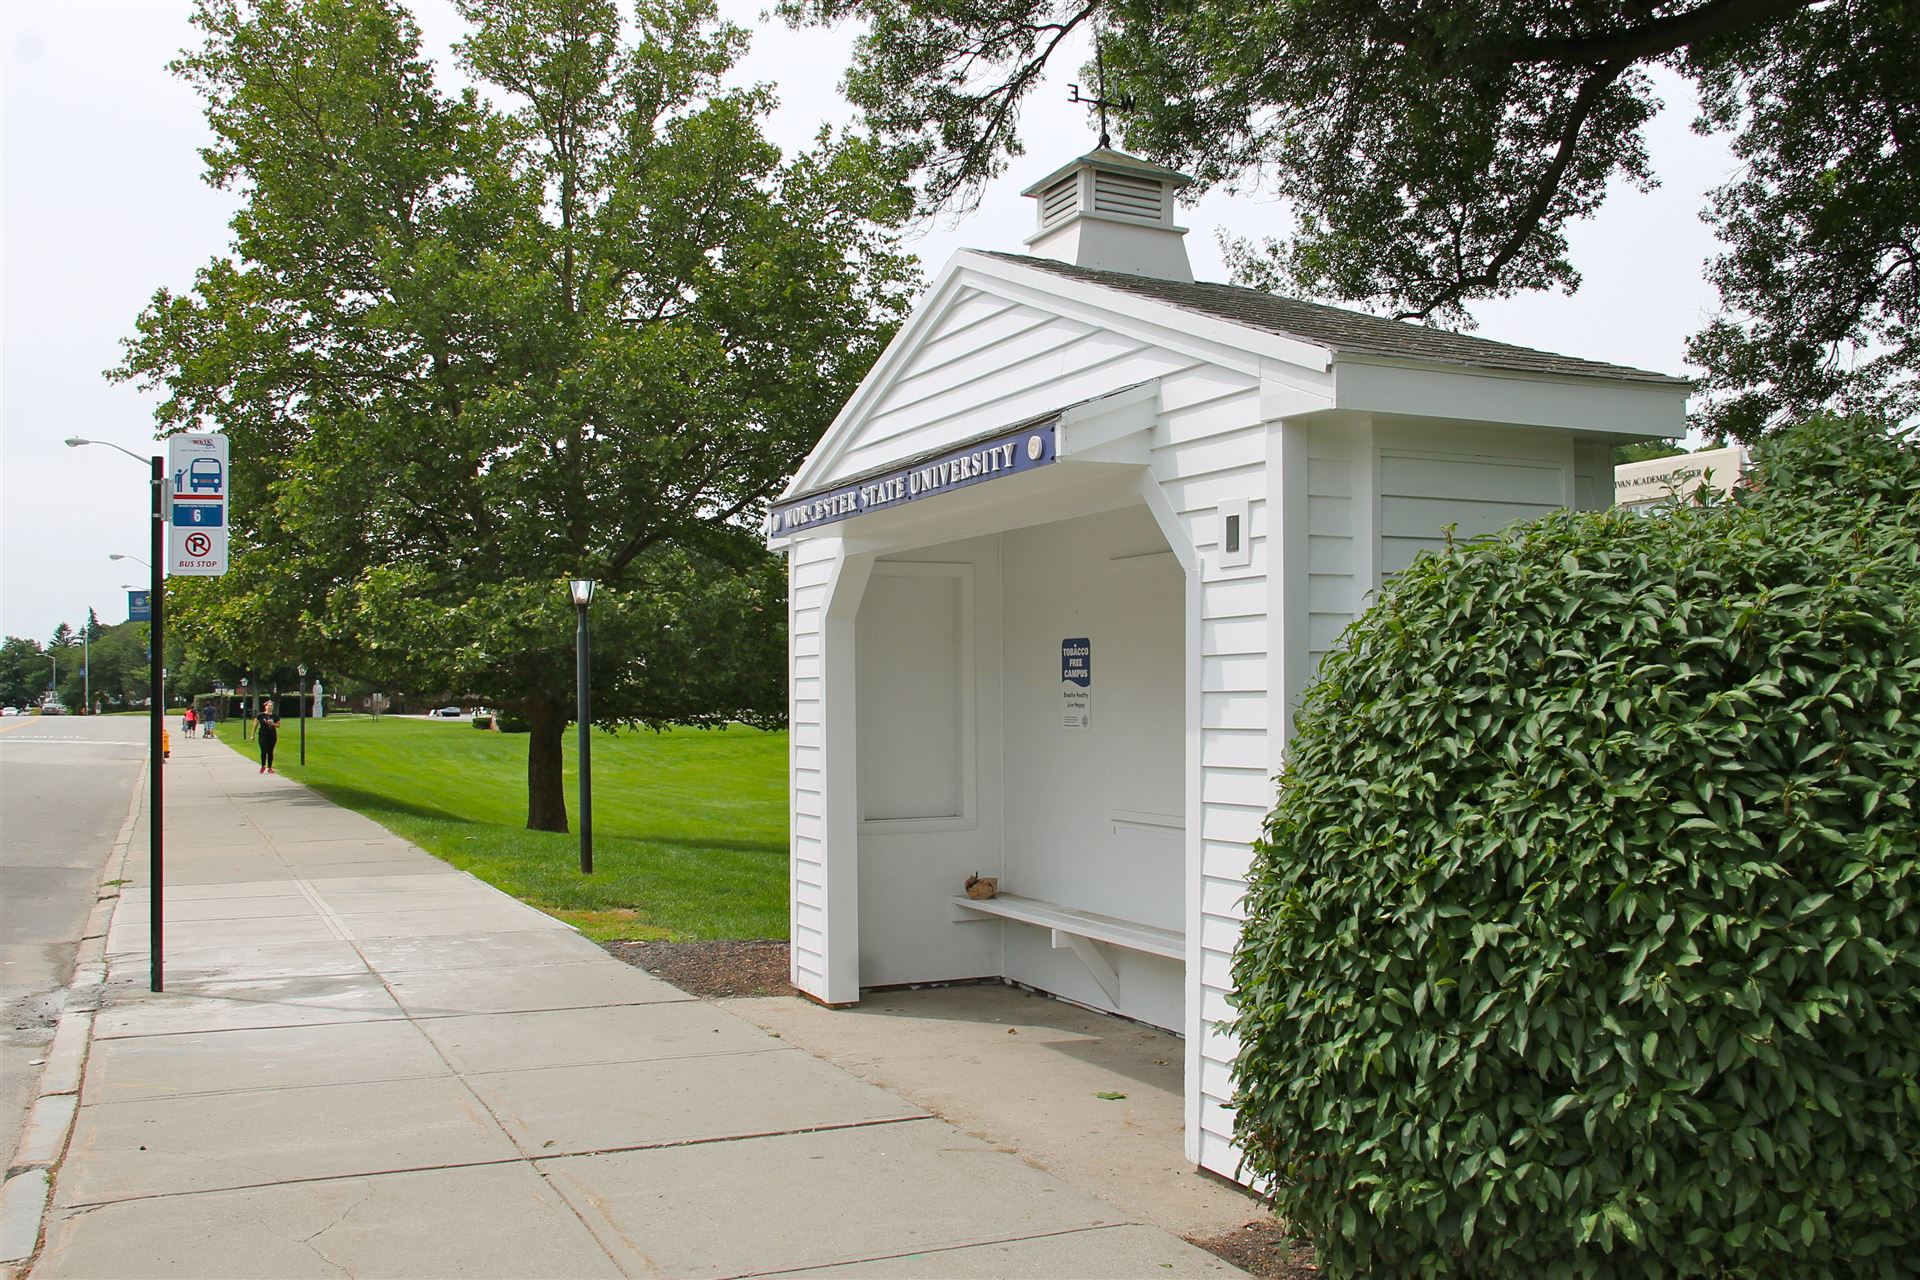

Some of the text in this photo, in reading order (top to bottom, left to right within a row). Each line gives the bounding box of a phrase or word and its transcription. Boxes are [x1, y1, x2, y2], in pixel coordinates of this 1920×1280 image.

[1615, 469, 1702, 489] IVAN ACADEMIC NTER
[784, 442, 1016, 528] WORCESTER STATE UNIVERSITY
[194, 509, 202, 522] 6
[193, 537, 205, 552] P
[179, 560, 217, 568] BUS STOP
[1063, 648, 1088, 656] TOBACCO
[1070, 658, 1082, 666] FREE
[1064, 670, 1088, 678] CAMPUS
